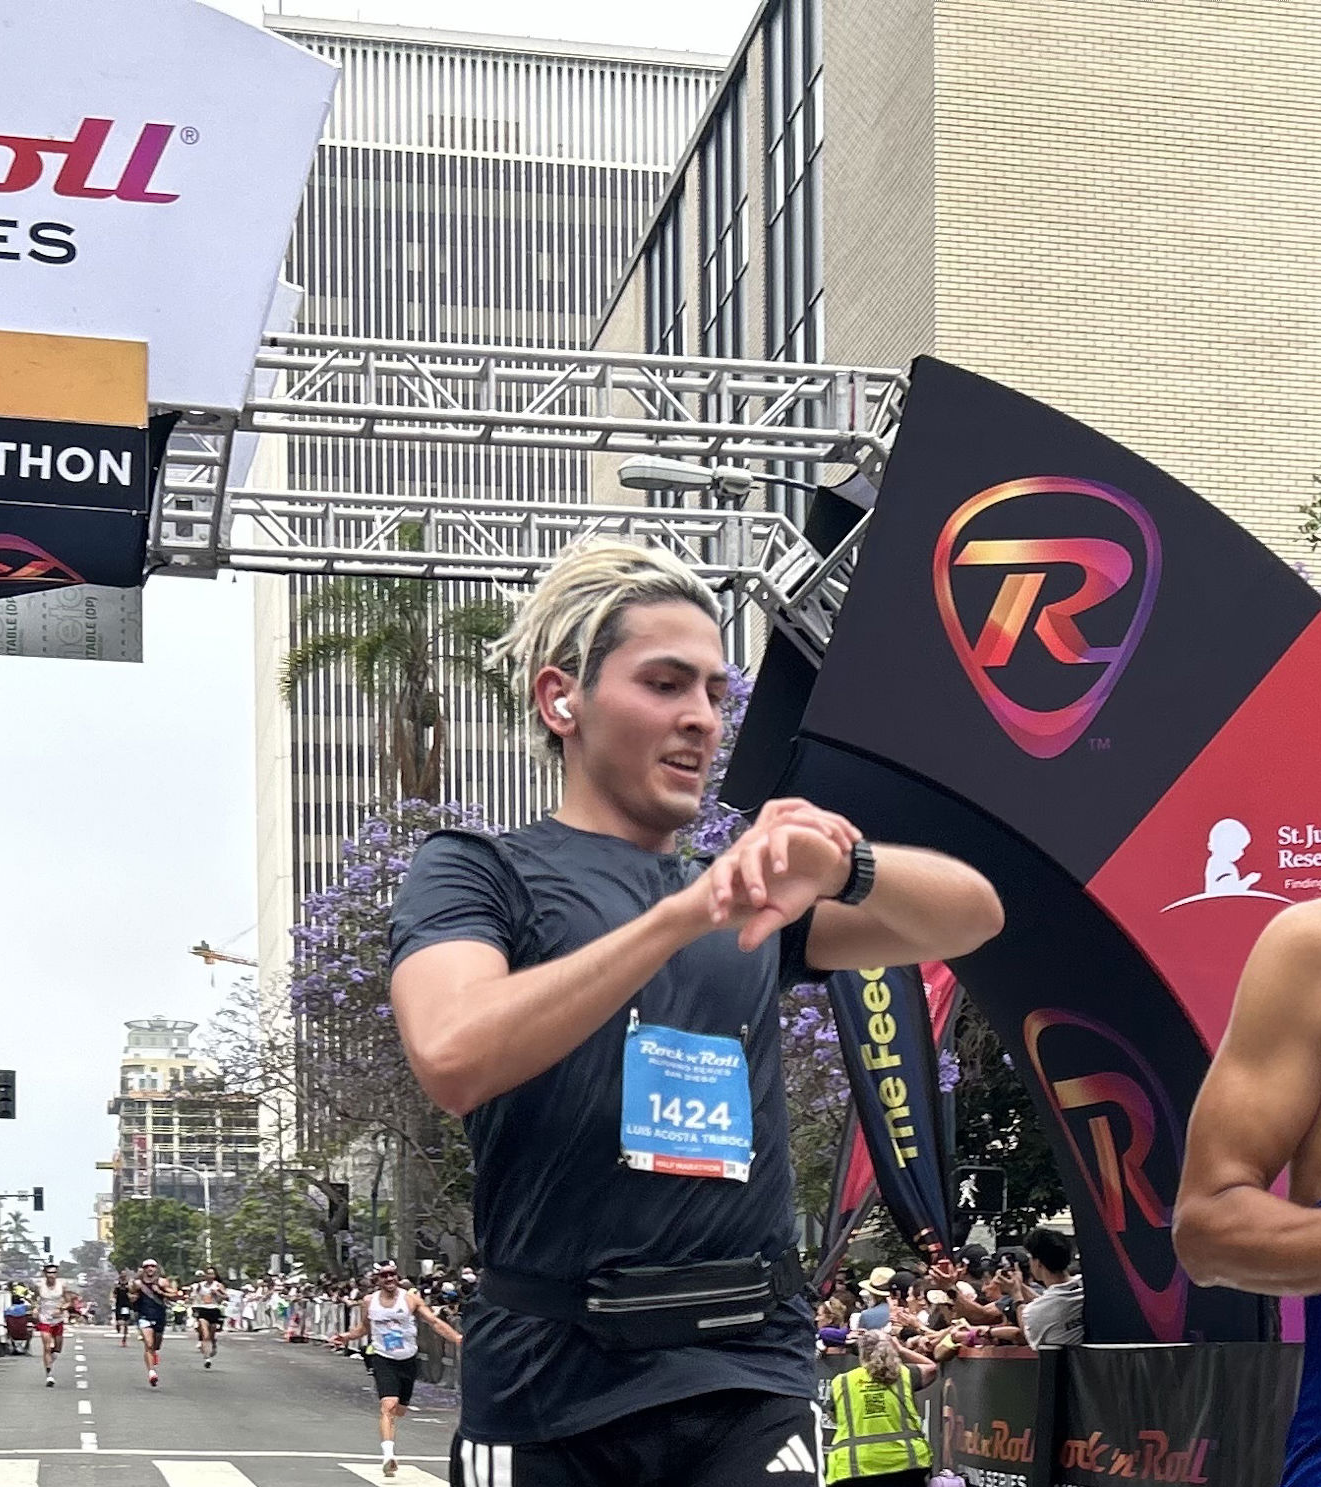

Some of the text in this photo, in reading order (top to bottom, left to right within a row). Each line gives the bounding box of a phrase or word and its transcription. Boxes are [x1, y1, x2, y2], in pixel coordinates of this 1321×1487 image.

[1278, 825, 1304, 846] St.
[648, 1092, 733, 1131] 1424
[625, 1124, 653, 1137] LUIS
[653, 1128, 698, 1144] ACOSTA
